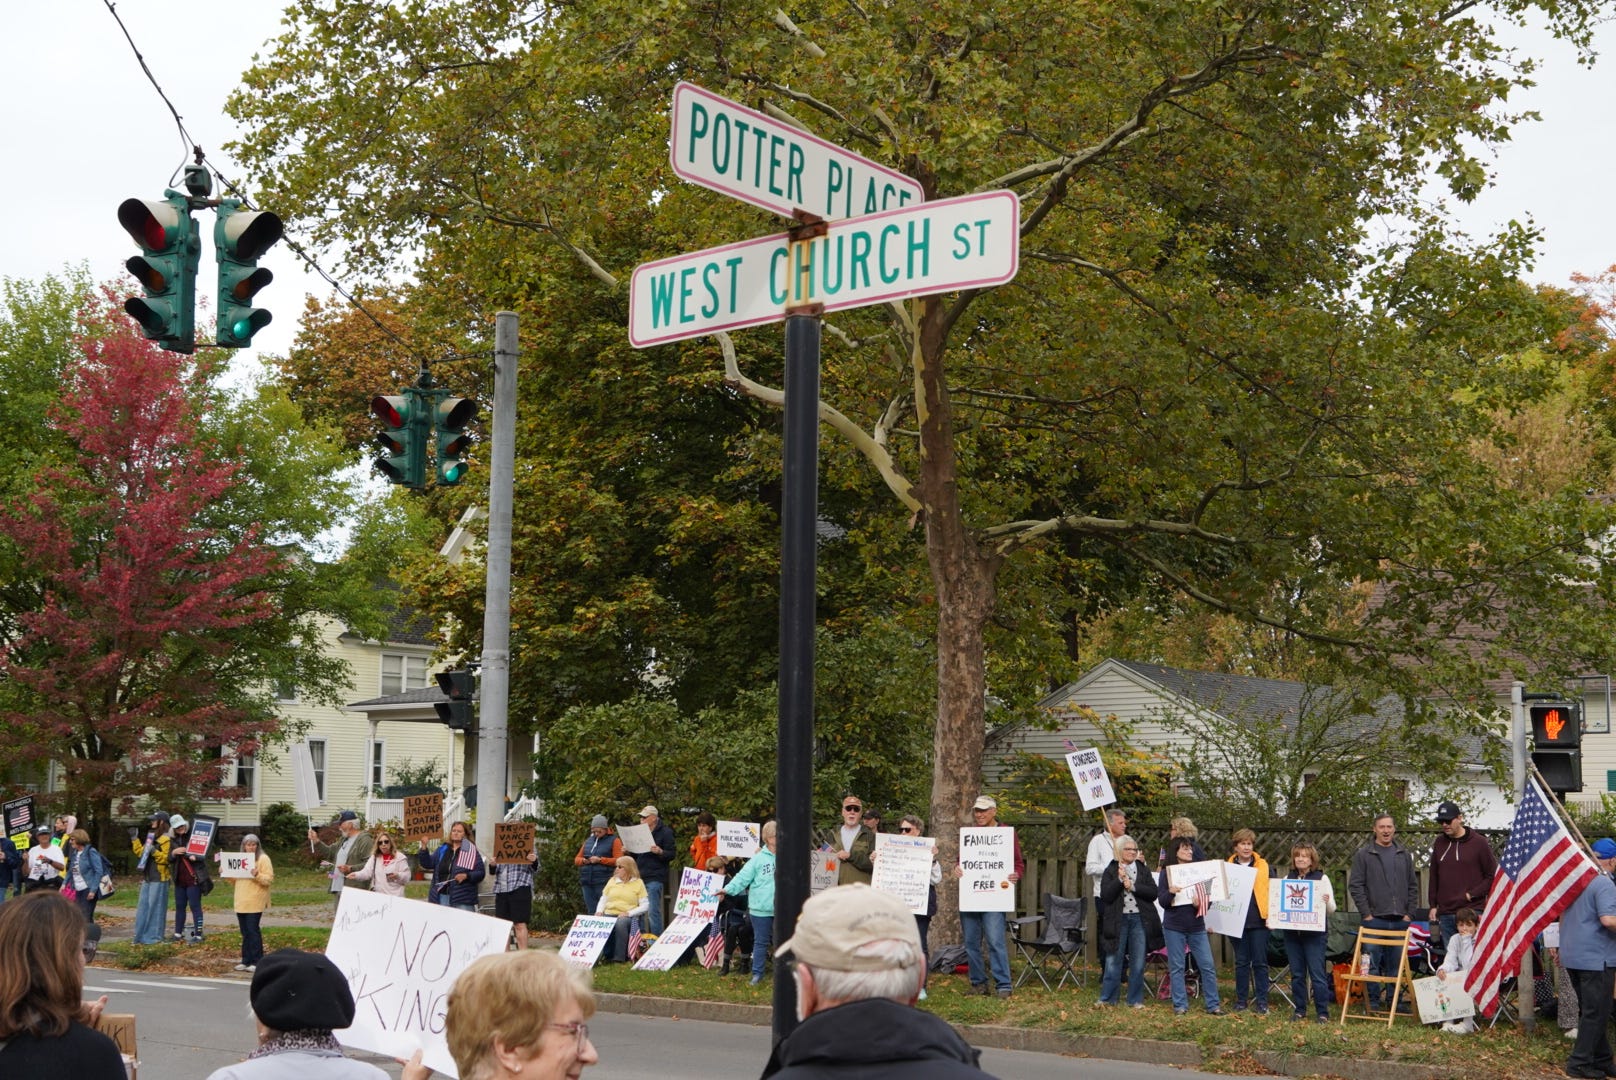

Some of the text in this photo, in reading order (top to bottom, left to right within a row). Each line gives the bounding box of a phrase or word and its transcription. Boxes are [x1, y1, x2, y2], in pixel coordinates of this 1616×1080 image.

[689, 102, 805, 204] POTTER
[651, 218, 991, 329] WEST CHURCH ST
[1072, 751, 1098, 767] CONGRESS
[408, 795, 440, 807] LOVE
[406, 804, 443, 816] AMERICA
[407, 814, 440, 827] LOATHE
[406, 823, 442, 835] TRUMP
[499, 832, 530, 841] VANCE
[963, 834, 1003, 847] FAMILIES
[503, 840, 526, 850] GO
[496, 850, 531, 860] AWAY
[962, 860, 1004, 870] TOGETHER
[704, 875, 713, 887] if
[973, 880, 995, 890] FREE
[677, 899, 689, 912] of
[689, 900, 715, 920] Trump
[579, 919, 614, 929] SUPPORT
[570, 930, 610, 939] PORTLAND
[660, 935, 692, 944] LEADER
[568, 940, 583, 948] NOT
[385, 921, 452, 983] NO
[637, 959, 670, 969] LOSER
